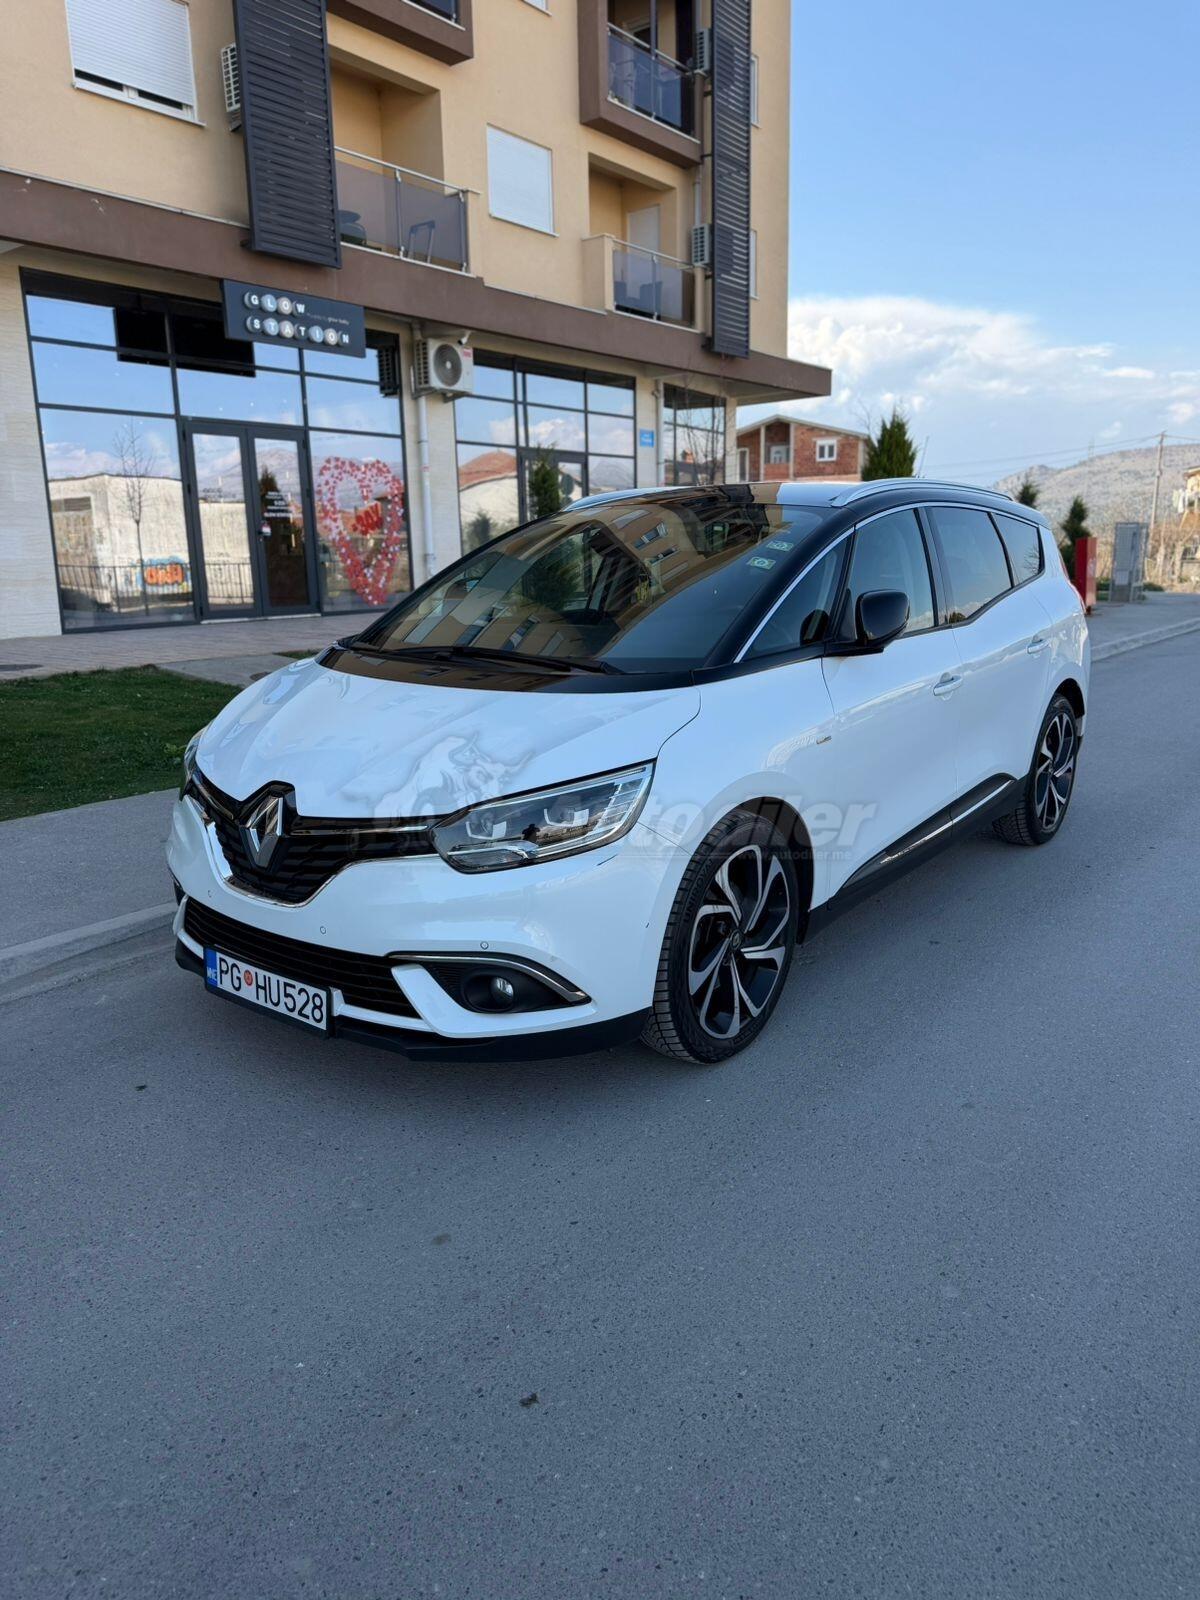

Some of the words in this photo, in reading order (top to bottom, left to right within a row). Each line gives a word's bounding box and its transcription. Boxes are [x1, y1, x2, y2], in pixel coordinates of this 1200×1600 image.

[249, 293, 306, 314] GLOW
[252, 317, 350, 345] STATION
[219, 956, 242, 992] PG
[254, 971, 324, 1024] HU528
